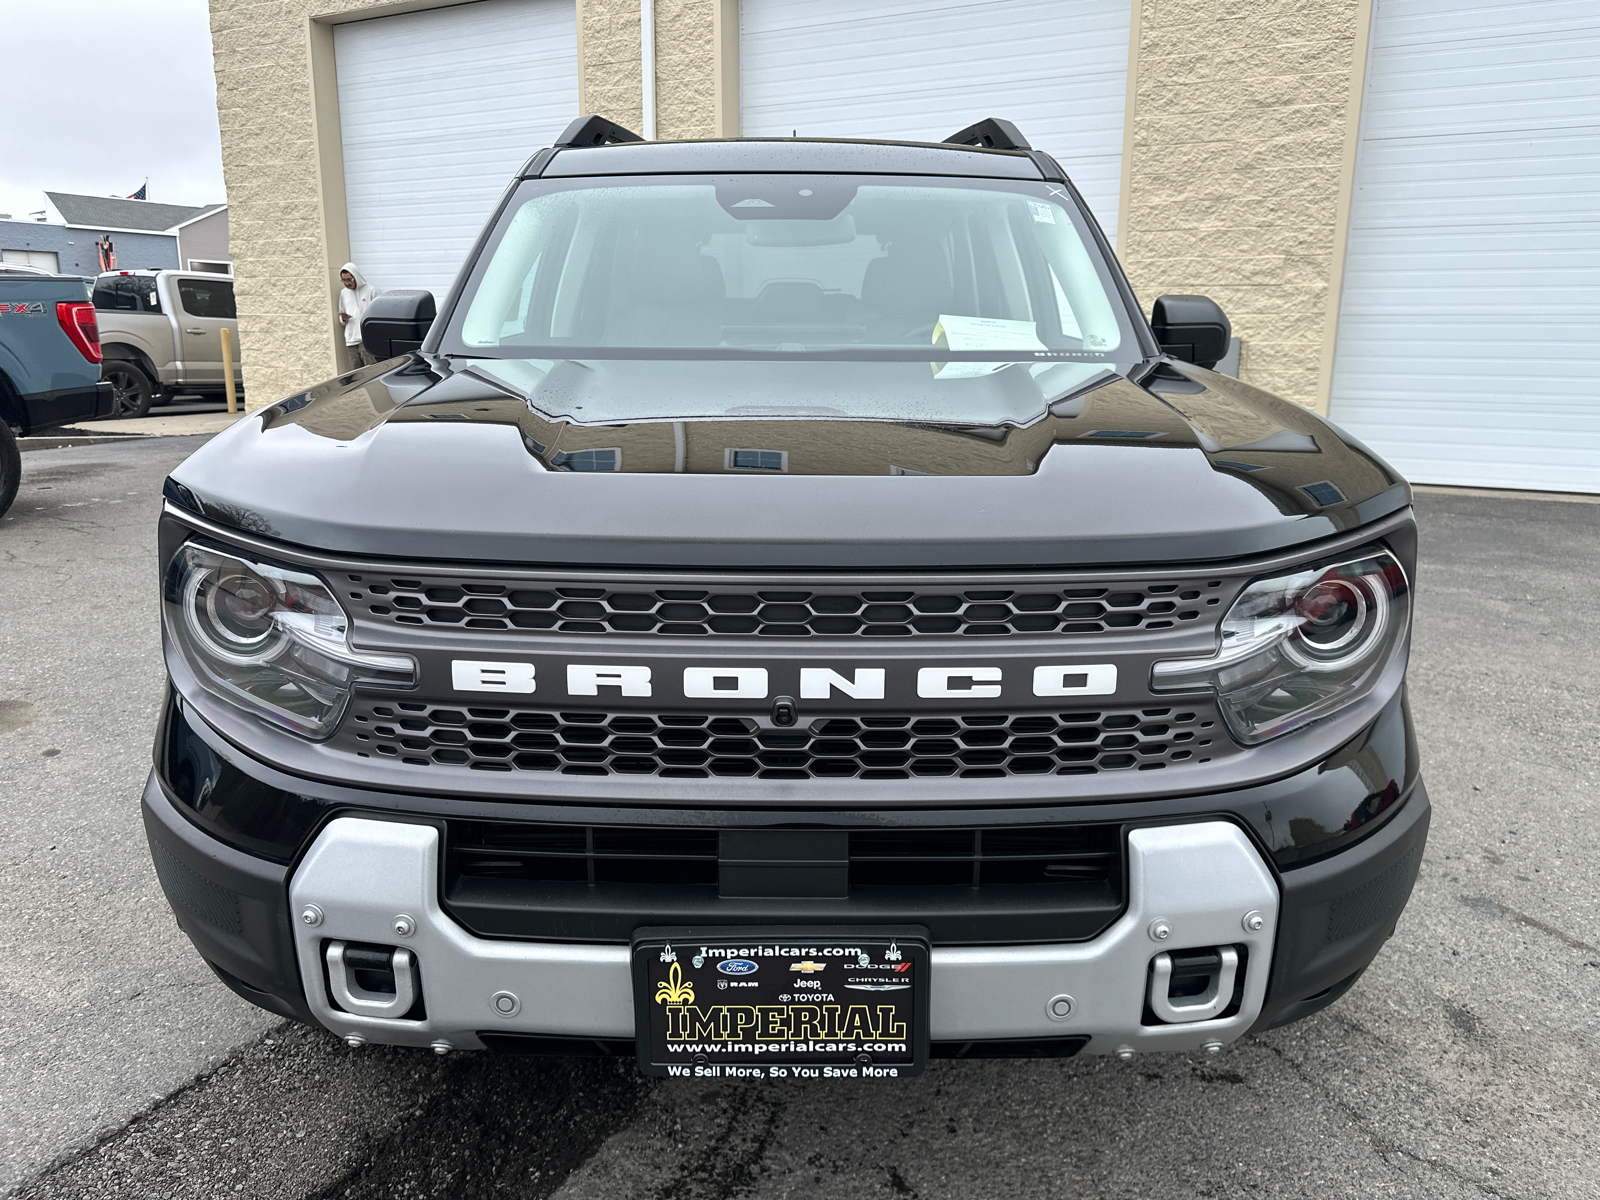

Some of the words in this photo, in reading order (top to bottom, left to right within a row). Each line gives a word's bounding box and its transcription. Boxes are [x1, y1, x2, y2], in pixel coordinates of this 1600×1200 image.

[451, 659, 1118, 699] BRONCO
[700, 946, 862, 959] Imperialcars.com
[726, 961, 750, 973] Ford
[793, 978, 822, 990] Jeep
[793, 994, 835, 1002] TOYOTA
[666, 1005, 907, 1040] IMPERIAL
[666, 1041, 907, 1054] www.imperialcars.com
[667, 1066, 691, 1077] We
[694, 1066, 720, 1077] Sell
[725, 1066, 765, 1079] More,
[769, 1067, 788, 1077] So
[792, 1067, 819, 1077] You
[823, 1067, 858, 1077] Save
[862, 1067, 898, 1077] More
